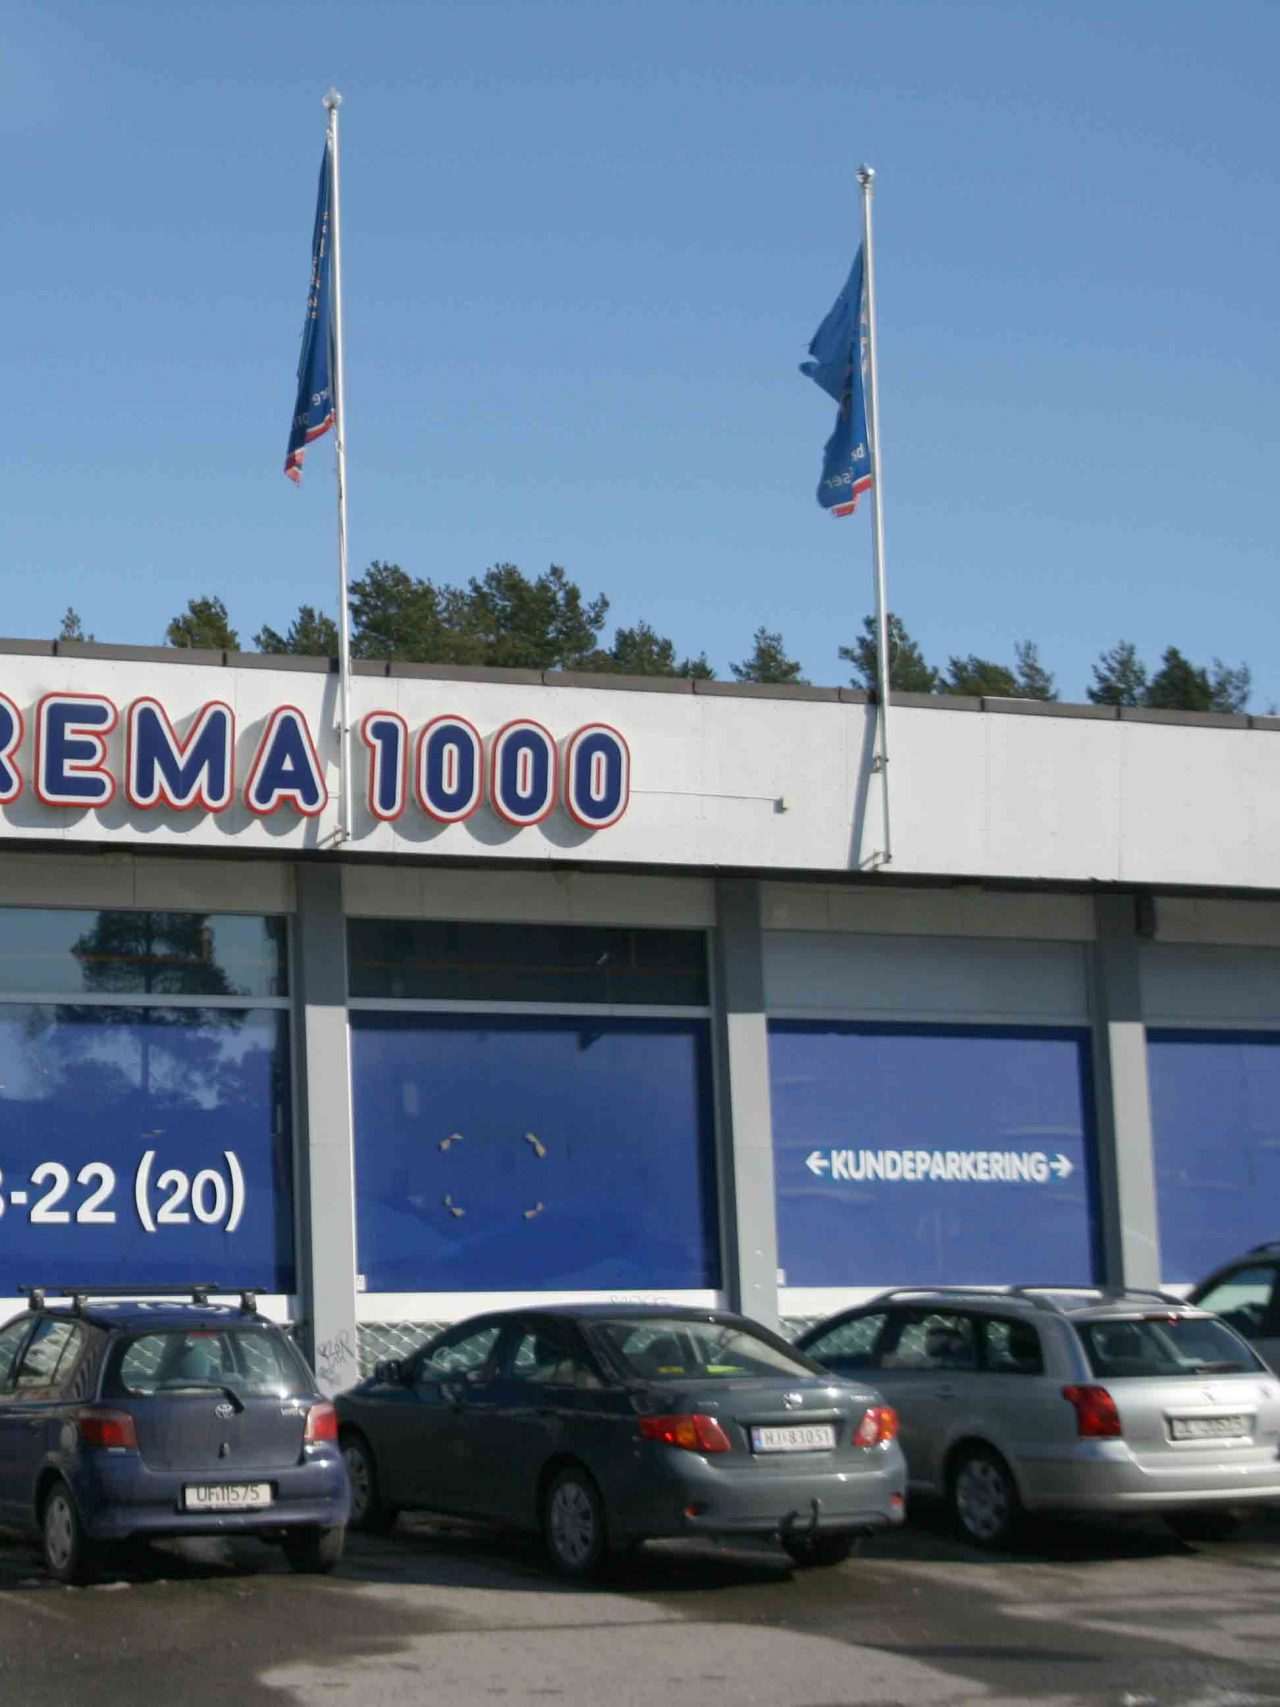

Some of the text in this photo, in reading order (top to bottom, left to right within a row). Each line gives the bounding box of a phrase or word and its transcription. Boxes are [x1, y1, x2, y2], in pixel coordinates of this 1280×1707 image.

[360, 711, 630, 829] 1000
[135, 1150, 246, 1232] (20)
[831, 1150, 1051, 1182] KUNDEPARKERING
